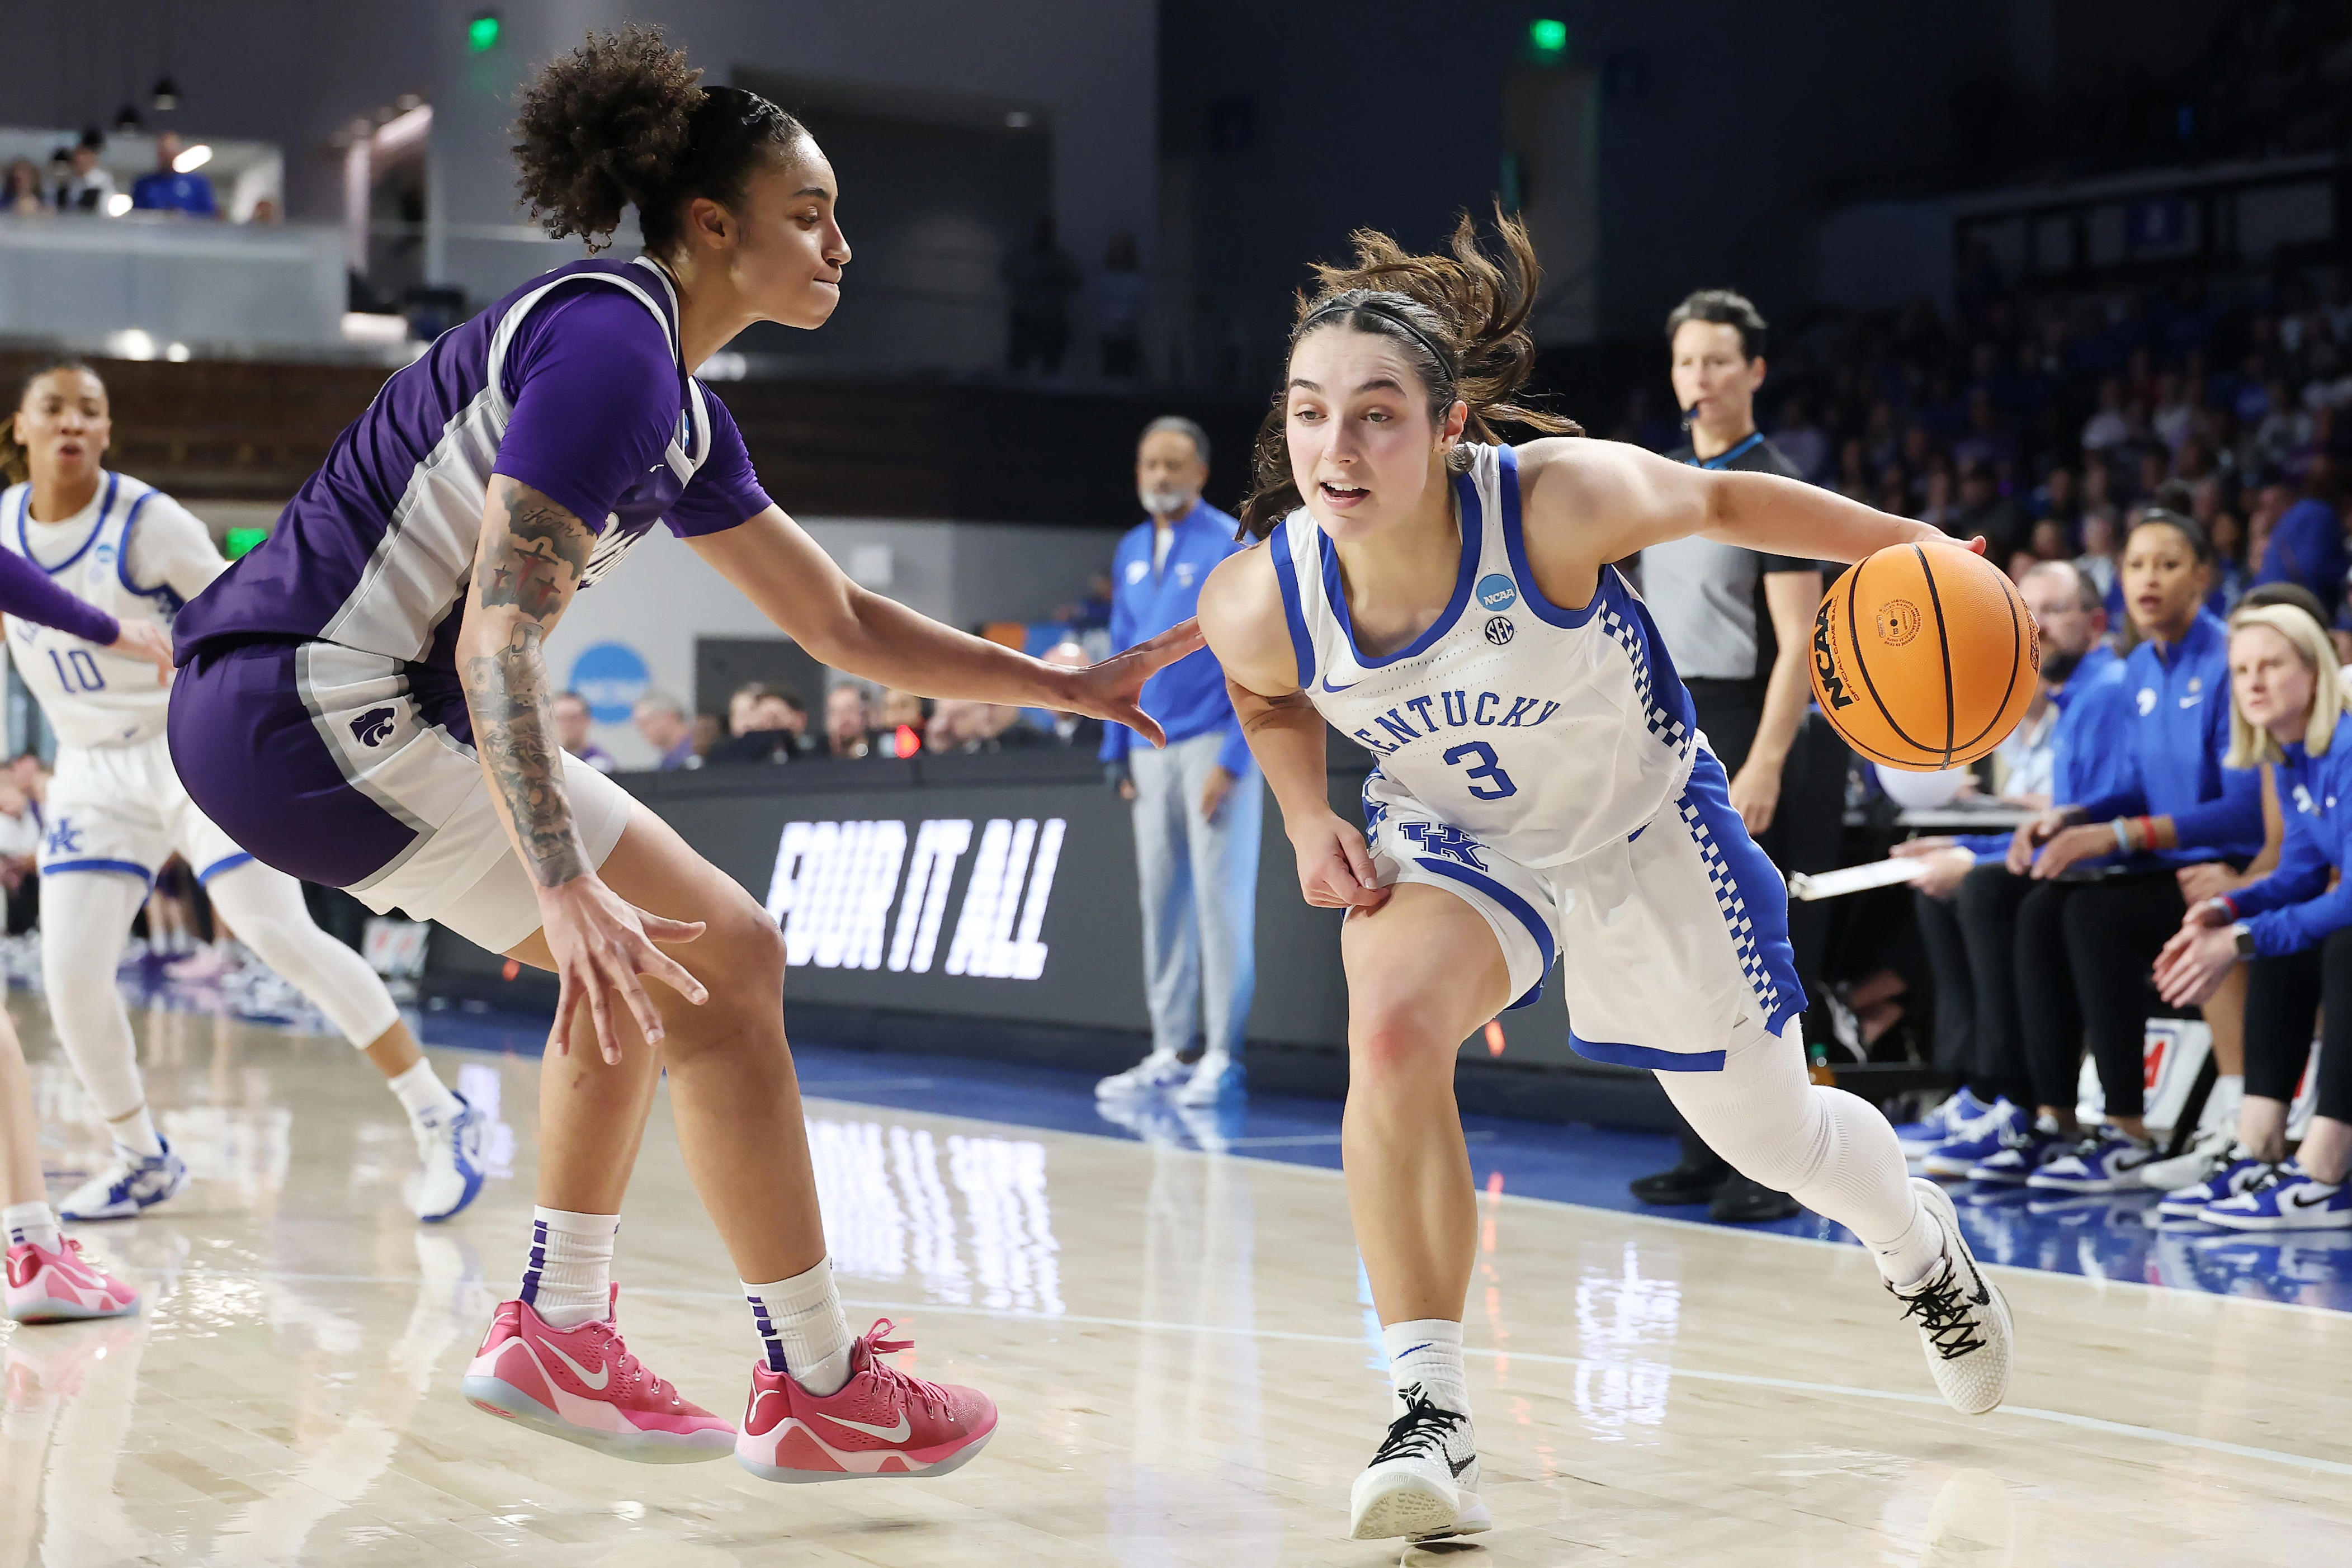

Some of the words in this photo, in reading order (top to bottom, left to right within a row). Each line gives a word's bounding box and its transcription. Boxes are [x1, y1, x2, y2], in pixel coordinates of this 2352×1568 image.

[1483, 588, 1515, 606] NCAA
[1486, 618, 1513, 644] SEC
[1814, 597, 1853, 710] NCAA
[49, 650, 105, 693] 10
[1837, 656, 1860, 701] OFFICIAL
[1354, 691, 1560, 754] ENTUCKY
[1443, 741, 1517, 800] 3
[887, 819, 974, 973] IT
[945, 818, 1066, 980] ALL
